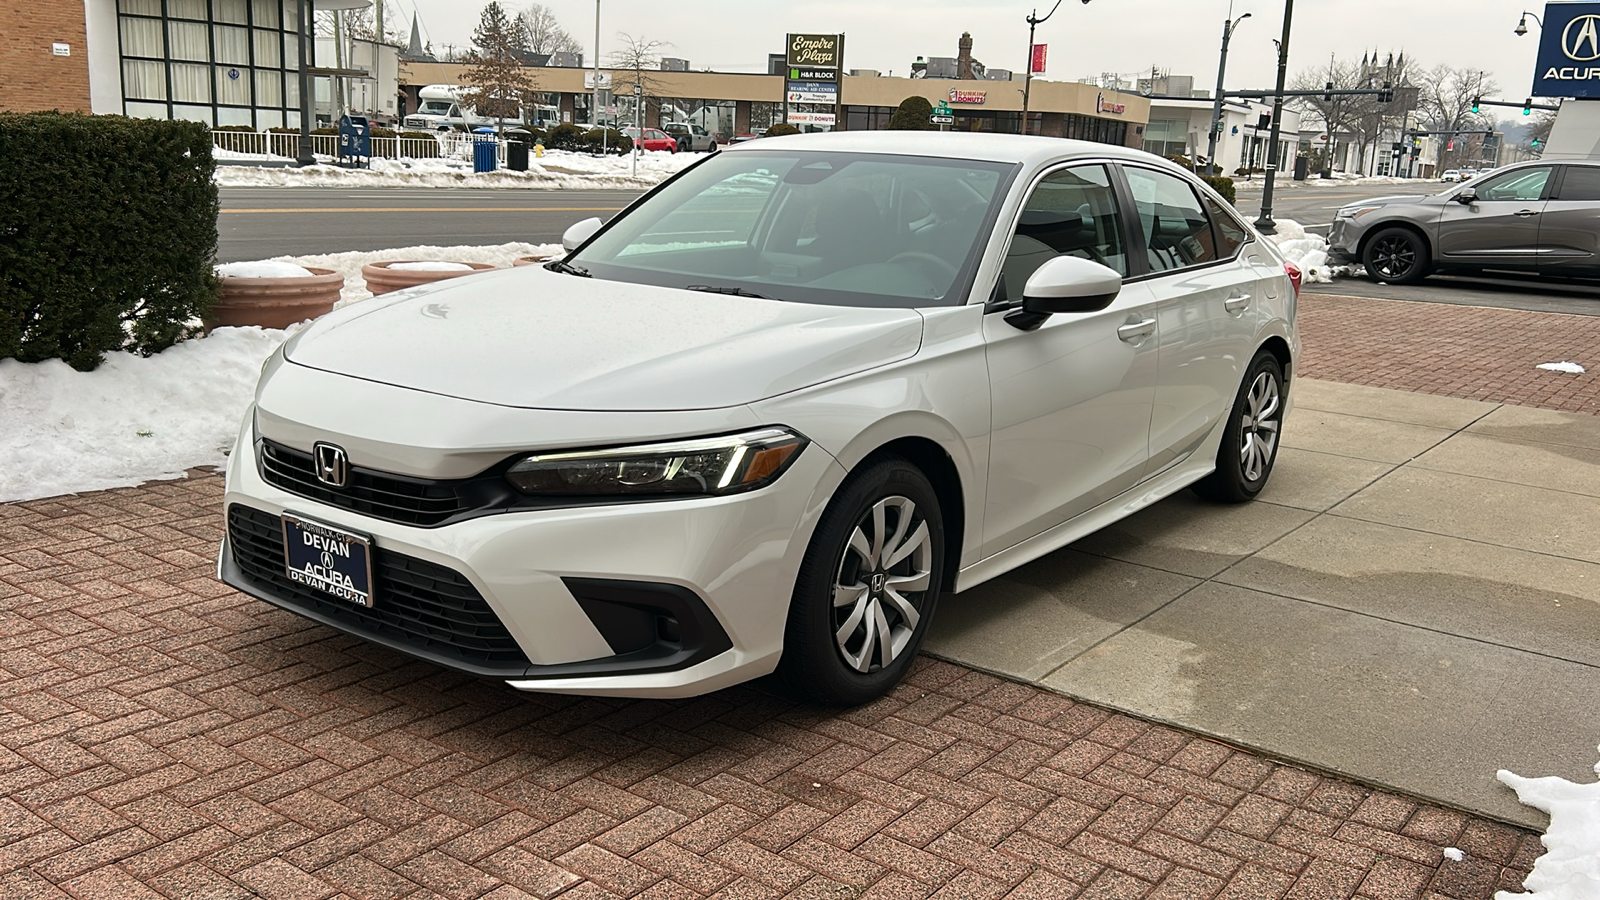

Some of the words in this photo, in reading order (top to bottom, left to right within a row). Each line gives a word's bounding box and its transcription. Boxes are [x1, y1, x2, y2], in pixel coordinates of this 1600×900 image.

[792, 36, 834, 50] Empire
[796, 49, 833, 65] Plaza
[303, 531, 350, 558] DEVAN
[291, 571, 326, 591] DEVAN
[329, 585, 366, 605] ACURA
[304, 562, 354, 590] ACURA
